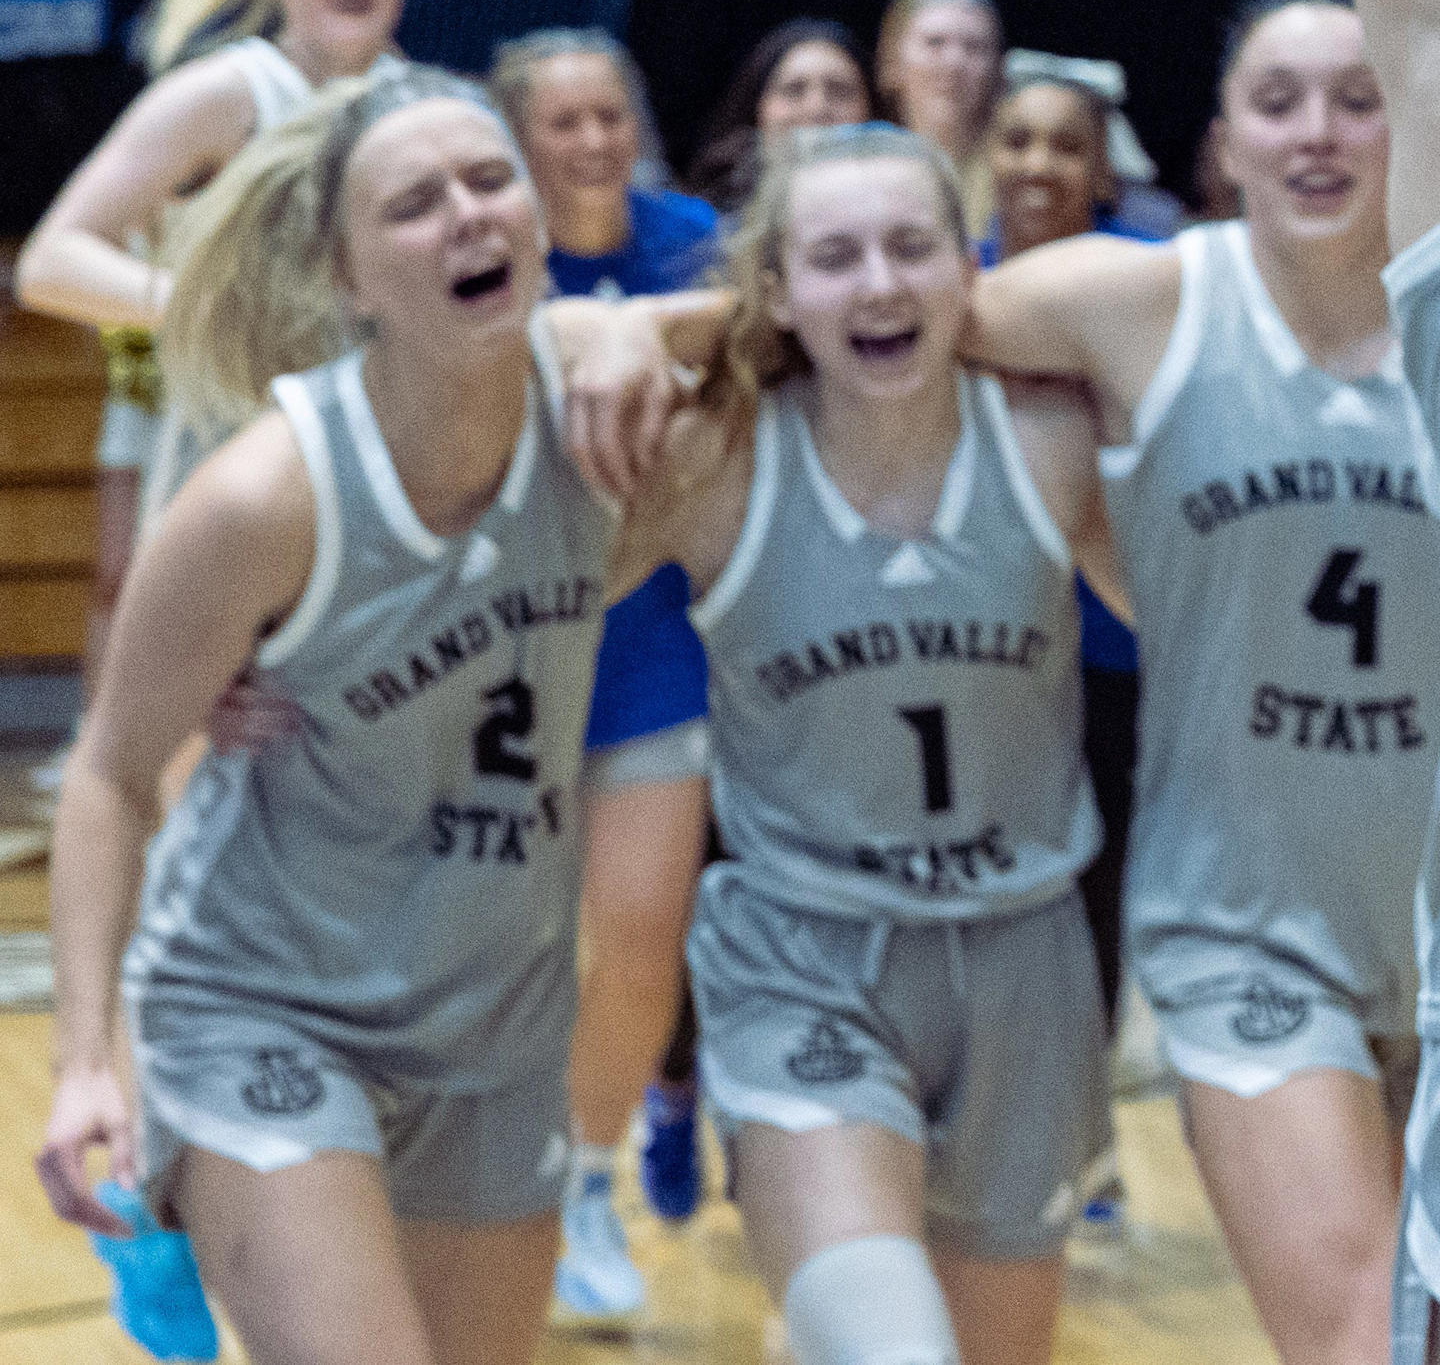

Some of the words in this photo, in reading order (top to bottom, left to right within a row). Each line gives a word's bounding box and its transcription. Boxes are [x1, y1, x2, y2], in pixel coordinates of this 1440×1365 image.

[1180, 458, 1337, 535] GRAND
[1344, 461, 1426, 516] VAL
[902, 618, 1050, 671] VALLE
[1305, 545, 1381, 668] 4
[342, 609, 493, 722] GRAND
[472, 675, 538, 782] 2
[897, 701, 953, 814] 1
[1250, 683, 1426, 753] STATE
[429, 788, 560, 864] STA
